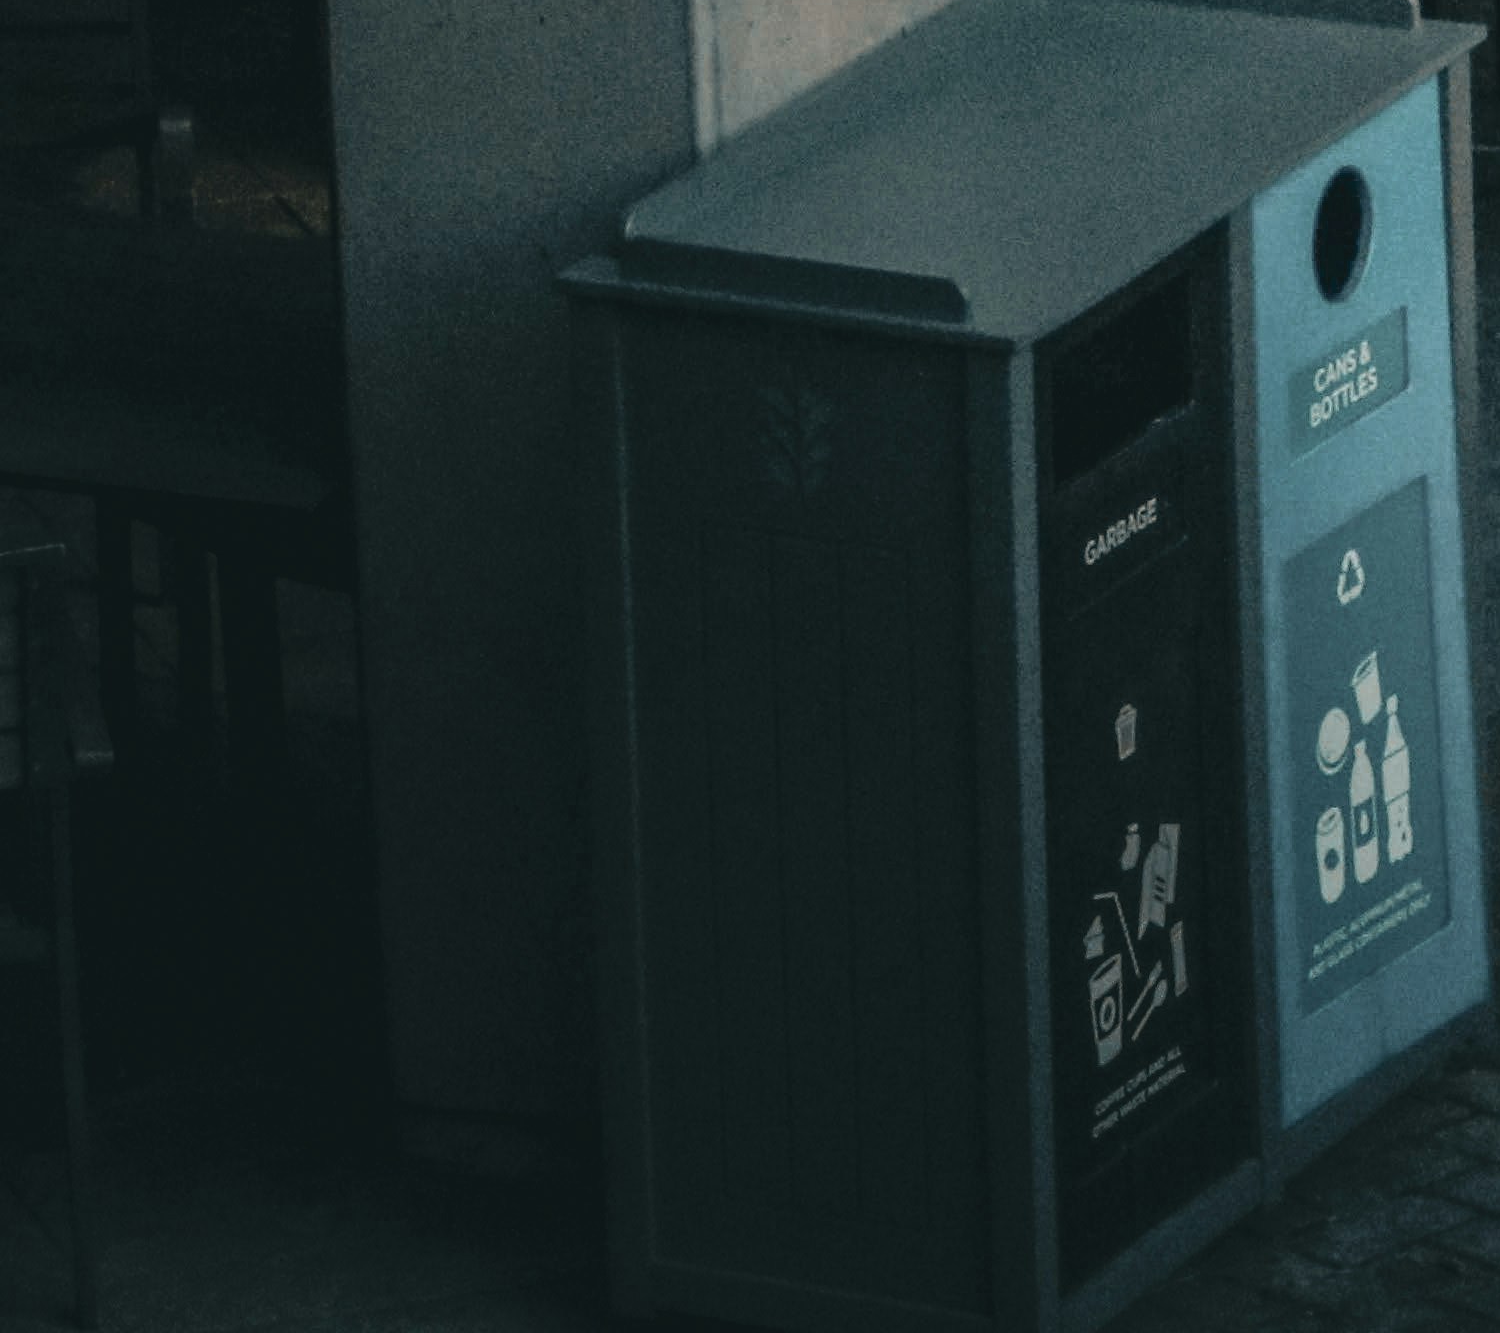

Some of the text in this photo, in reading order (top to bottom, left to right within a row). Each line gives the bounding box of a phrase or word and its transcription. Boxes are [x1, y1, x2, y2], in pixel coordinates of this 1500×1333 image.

[1309, 366, 1378, 428] BOTTLES
[1313, 340, 1372, 393] CANS &
[1083, 497, 1158, 566] GARBAGE
